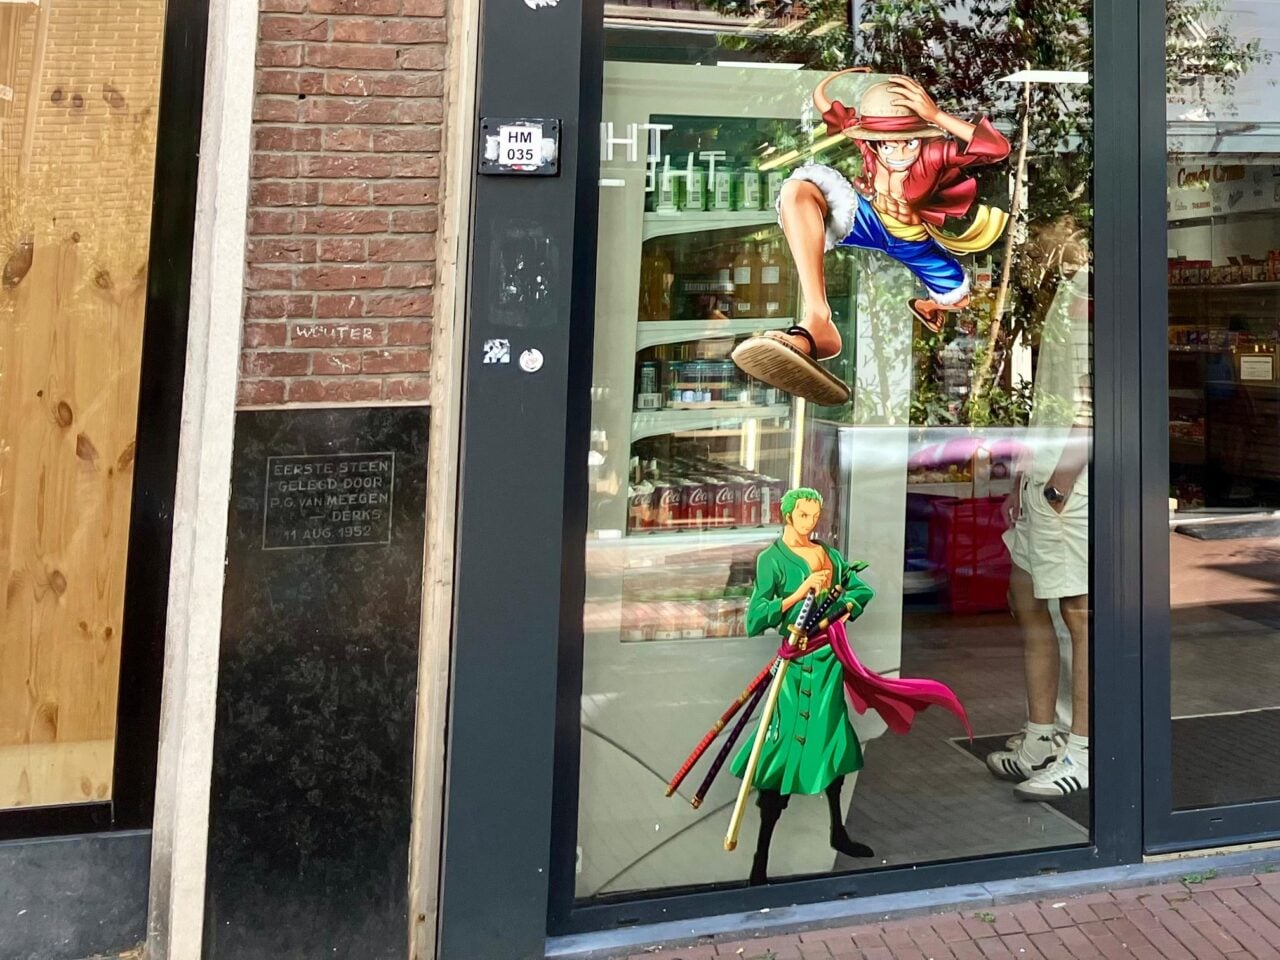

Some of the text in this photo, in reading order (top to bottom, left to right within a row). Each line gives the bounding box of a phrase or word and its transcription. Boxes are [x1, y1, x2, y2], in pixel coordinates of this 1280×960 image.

[507, 130, 533, 144] HM
[506, 148, 534, 161] 035
[273, 460, 389, 476] EERSTE STEEN
[278, 476, 383, 493] GELEGD DOOR
[298, 496, 324, 508] VAN
[326, 492, 389, 506] MEEGEN
[331, 508, 383, 522] DERKS
[338, 525, 373, 539] 1952
